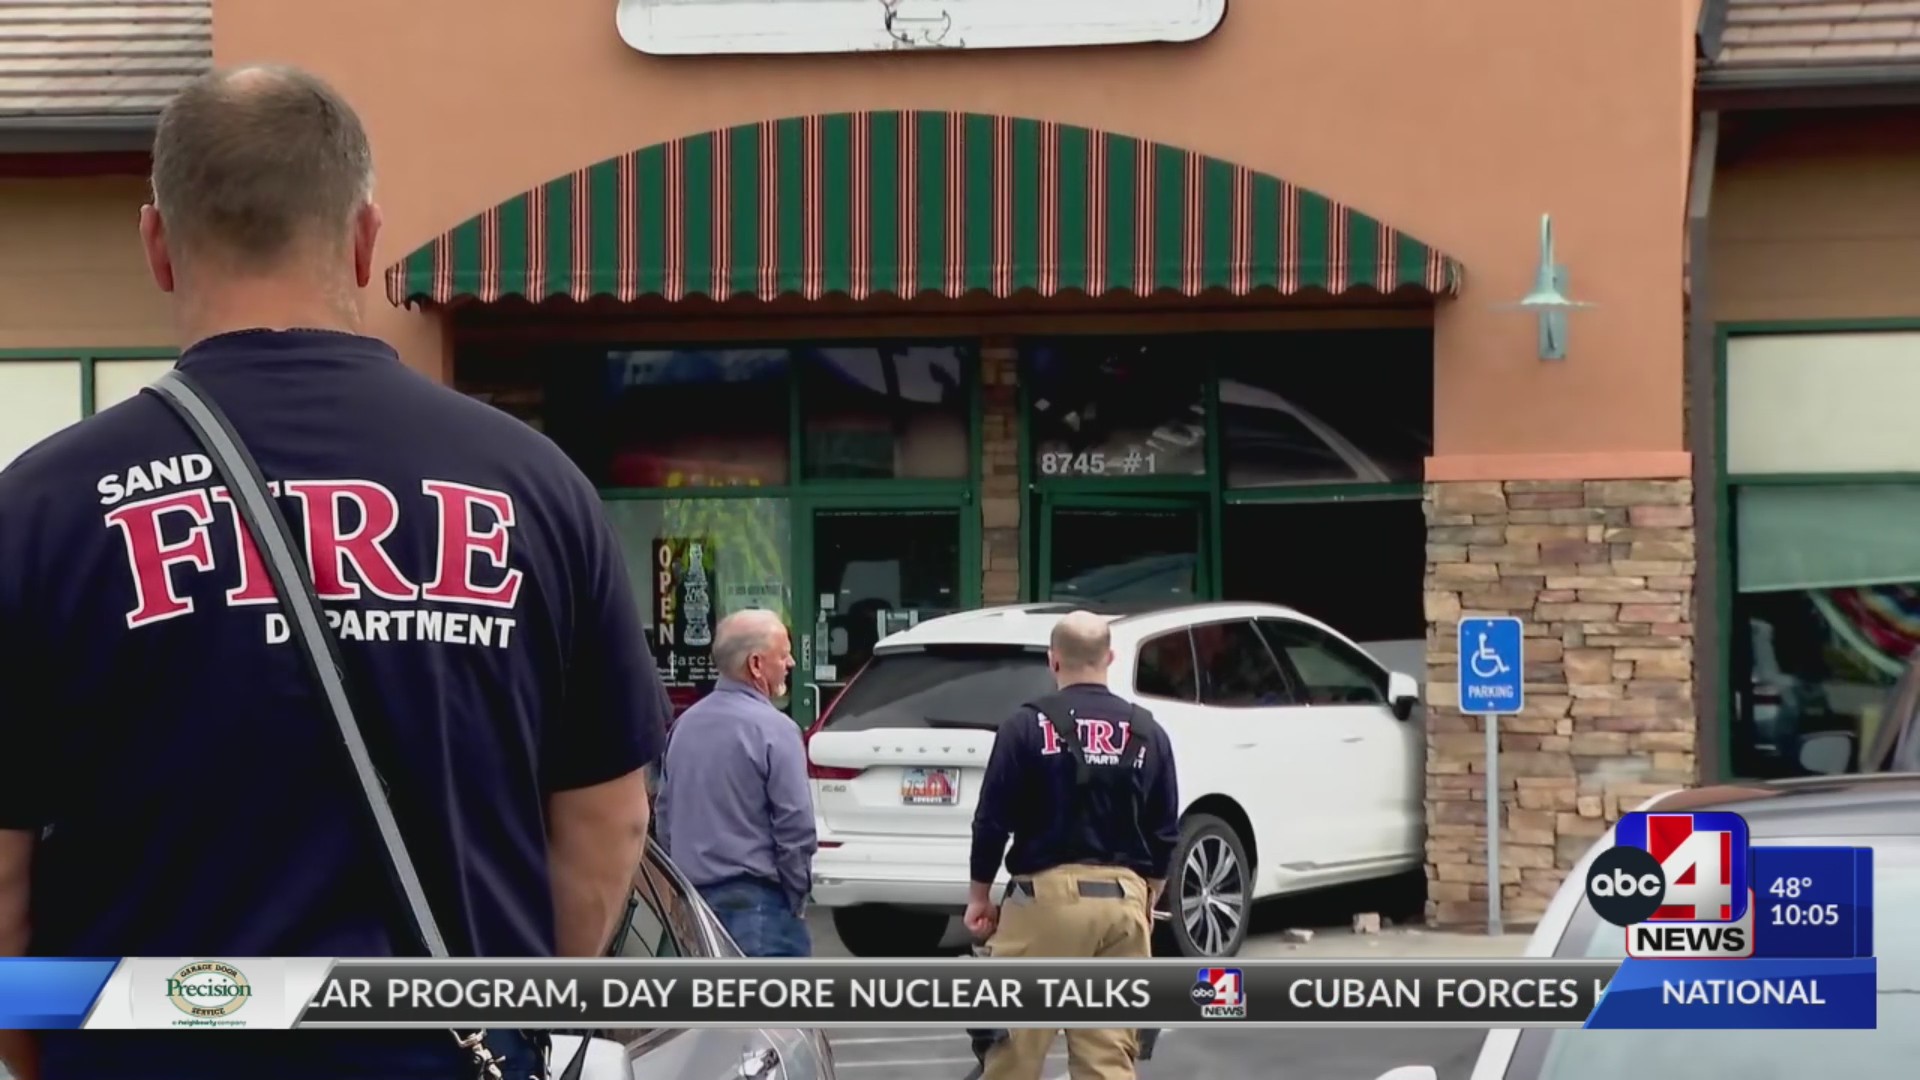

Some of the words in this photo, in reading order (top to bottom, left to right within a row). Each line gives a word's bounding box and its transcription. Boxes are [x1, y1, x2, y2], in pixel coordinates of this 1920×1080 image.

[1041, 453, 1105, 474] 8745
[1123, 453, 1156, 473] #1
[104, 479, 524, 630] FIRE
[659, 545, 675, 645] OPEN
[266, 610, 516, 649] DPARTMENT
[1468, 685, 1514, 698] PARKING
